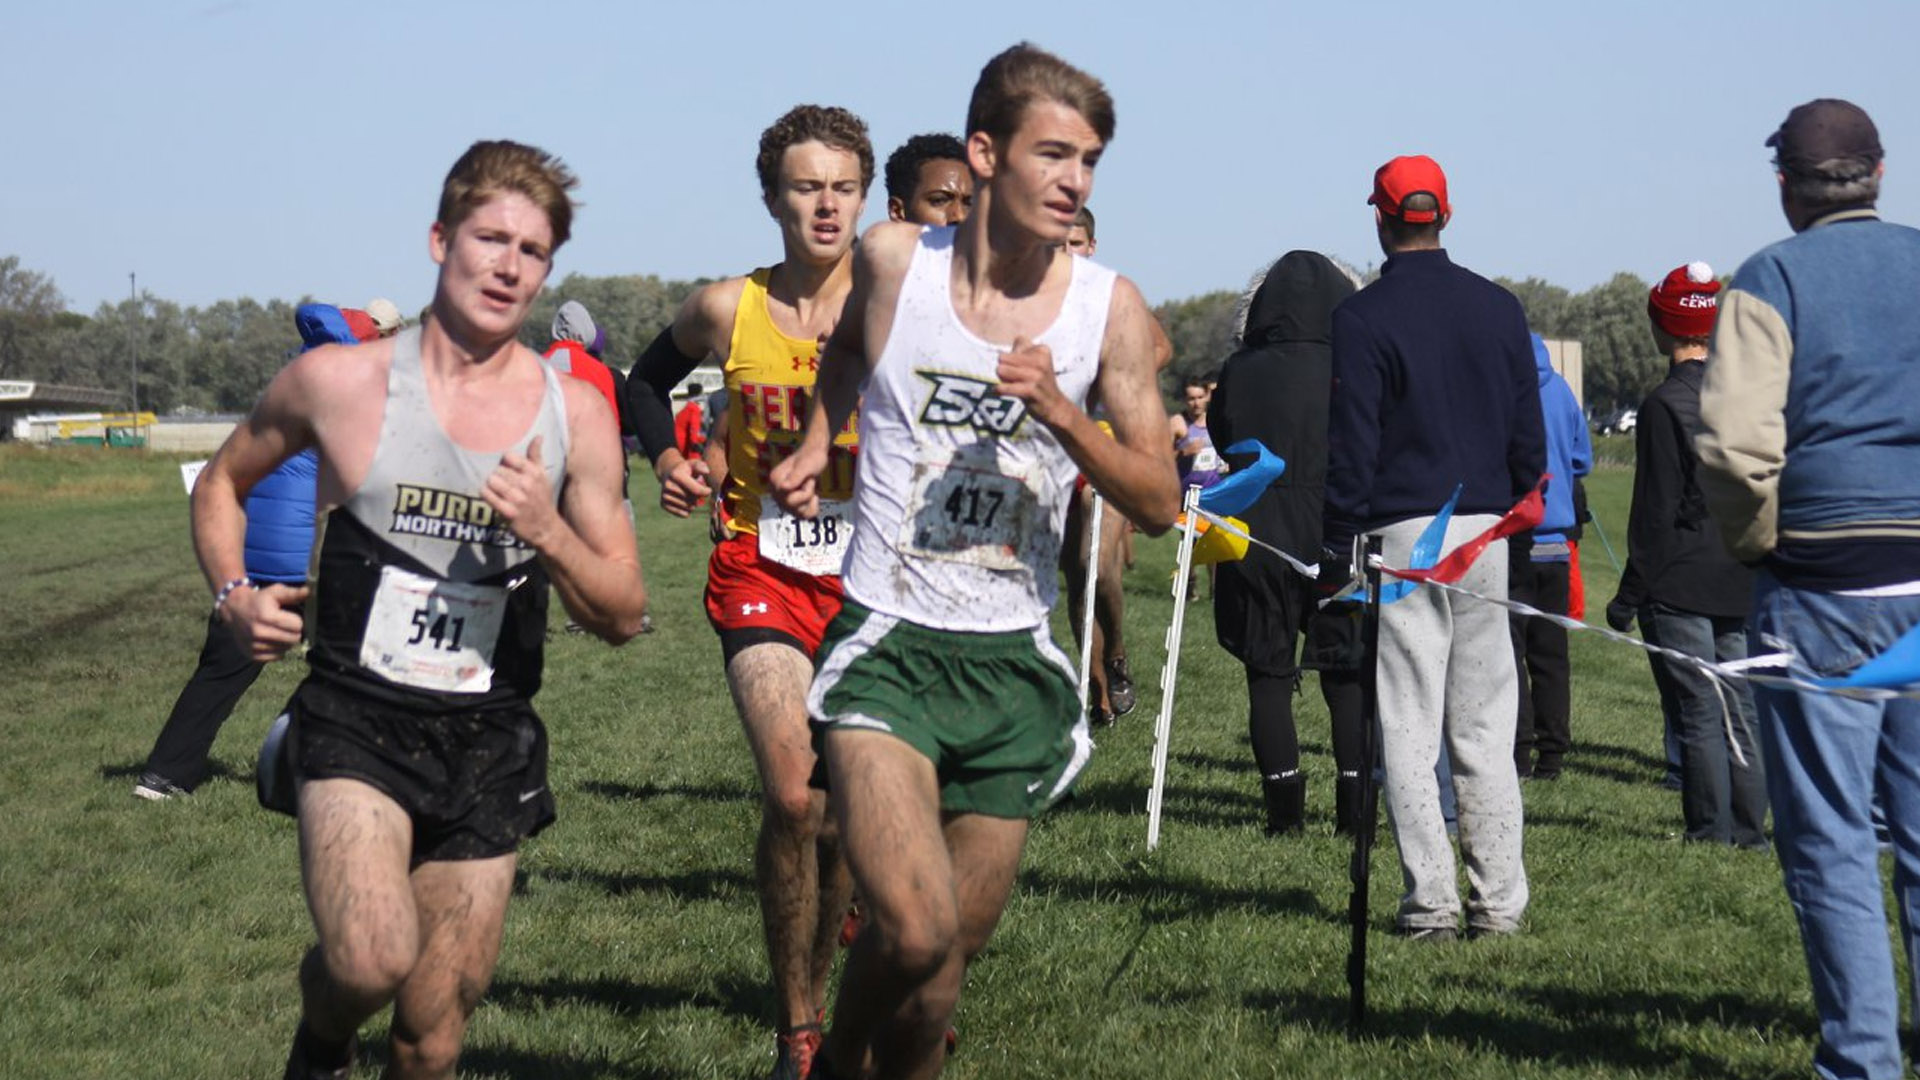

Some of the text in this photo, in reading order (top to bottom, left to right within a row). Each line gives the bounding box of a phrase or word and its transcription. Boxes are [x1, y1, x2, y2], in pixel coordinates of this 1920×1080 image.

[398, 486, 512, 528] PURD
[944, 485, 1005, 528] 417
[394, 513, 526, 549] NORTHWES
[790, 515, 839, 548] 138
[407, 608, 466, 653] 541
